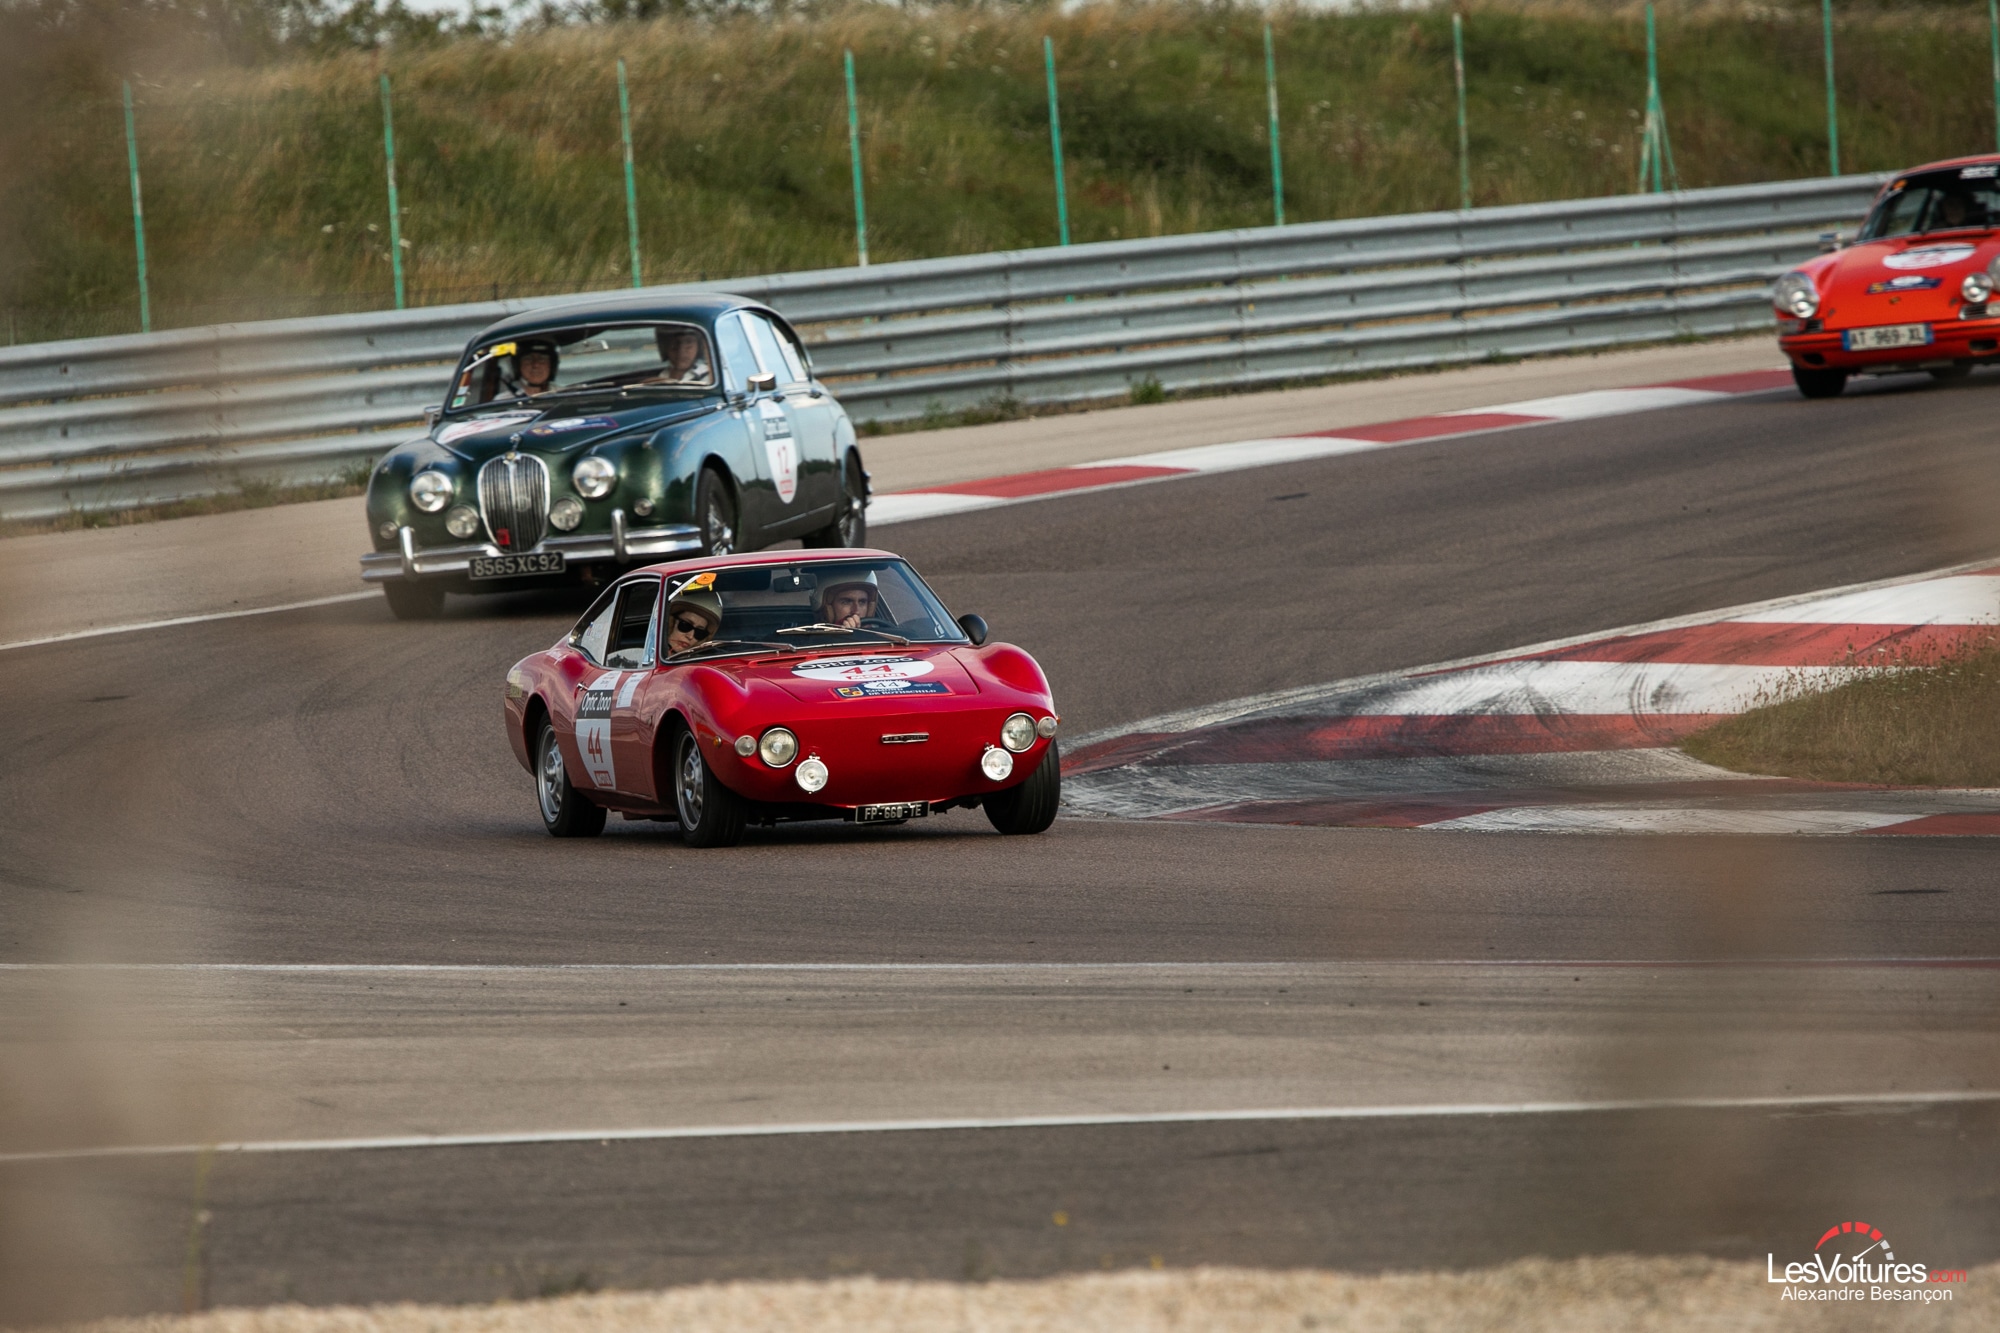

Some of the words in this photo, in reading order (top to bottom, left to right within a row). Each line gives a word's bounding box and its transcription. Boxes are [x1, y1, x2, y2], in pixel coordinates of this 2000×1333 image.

[797, 660, 857, 670] Optic
[862, 657, 914, 665] 2000
[841, 664, 894, 674] 44
[582, 691, 599, 717] Optic
[596, 691, 612, 711] 2000
[588, 727, 604, 763] 44
[864, 804, 922, 820] FP-660-TE
